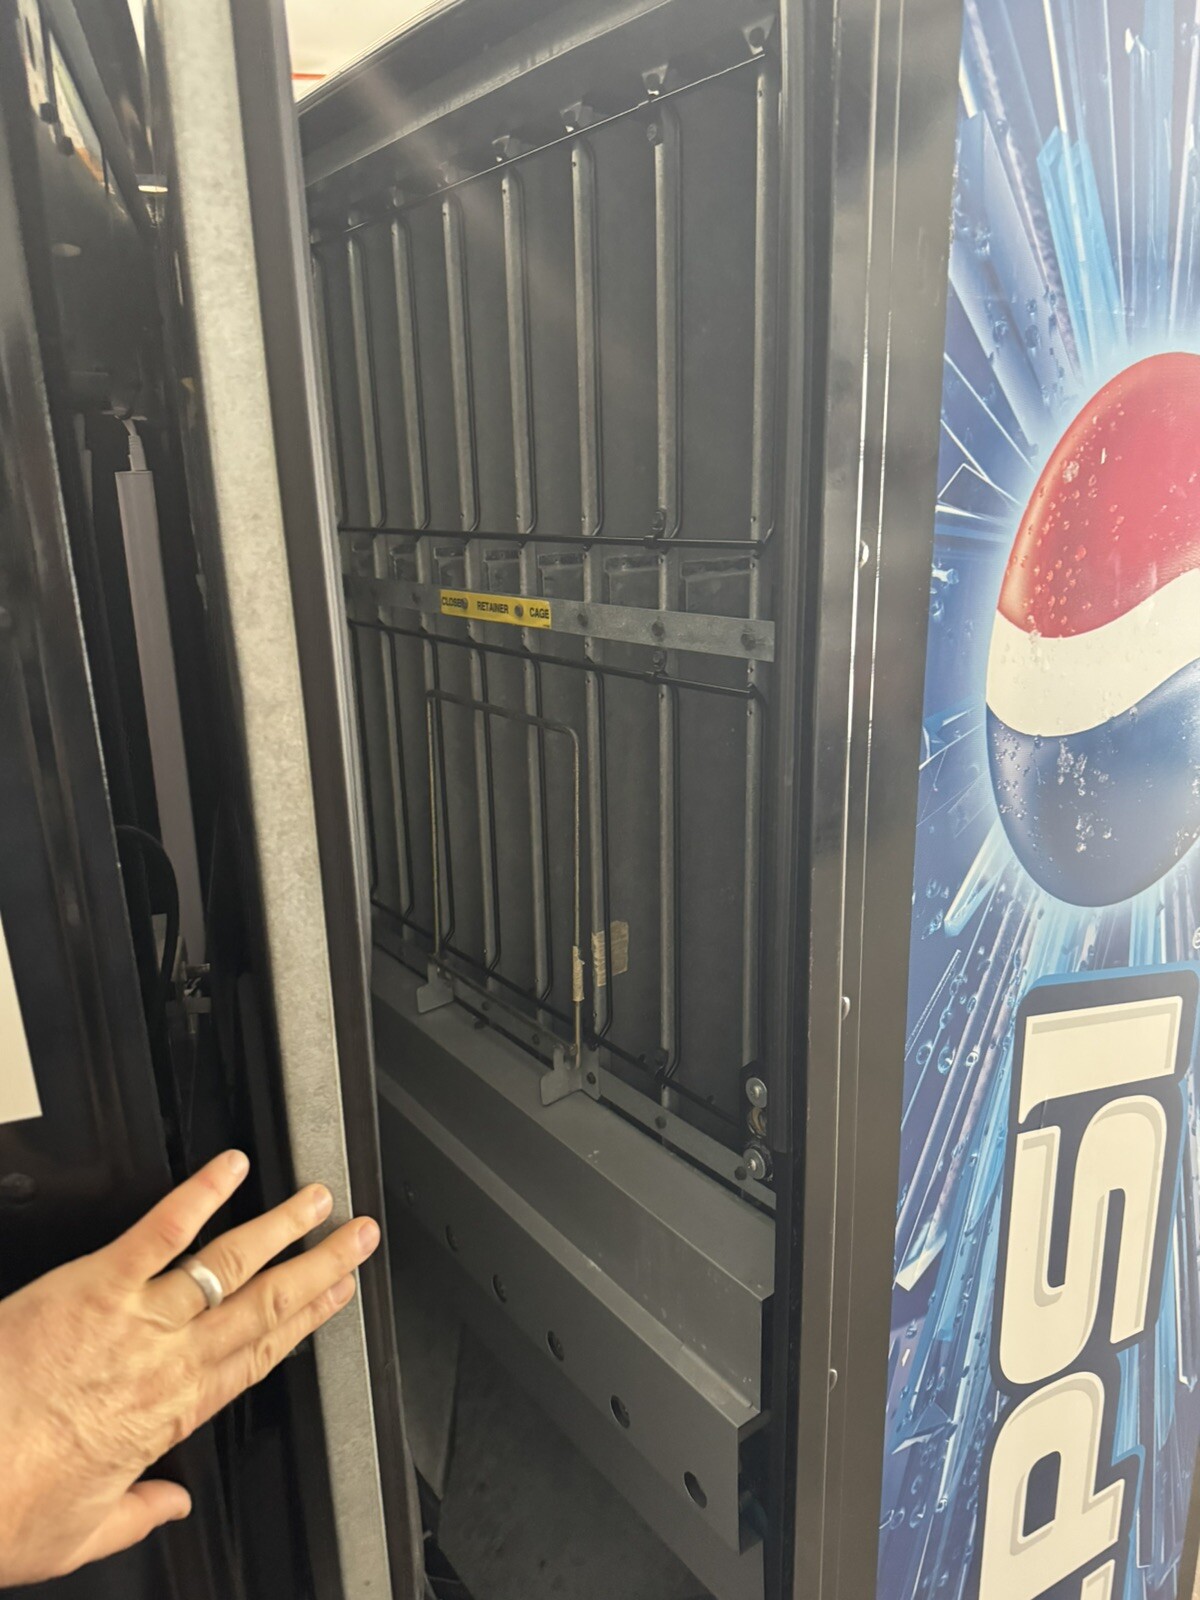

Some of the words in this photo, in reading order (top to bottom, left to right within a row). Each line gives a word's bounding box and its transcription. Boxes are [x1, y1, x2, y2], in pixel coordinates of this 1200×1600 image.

[477, 601, 509, 614] RETAINER
[529, 607, 550, 619] CAGE
[979, 996, 1183, 1600] PSI
